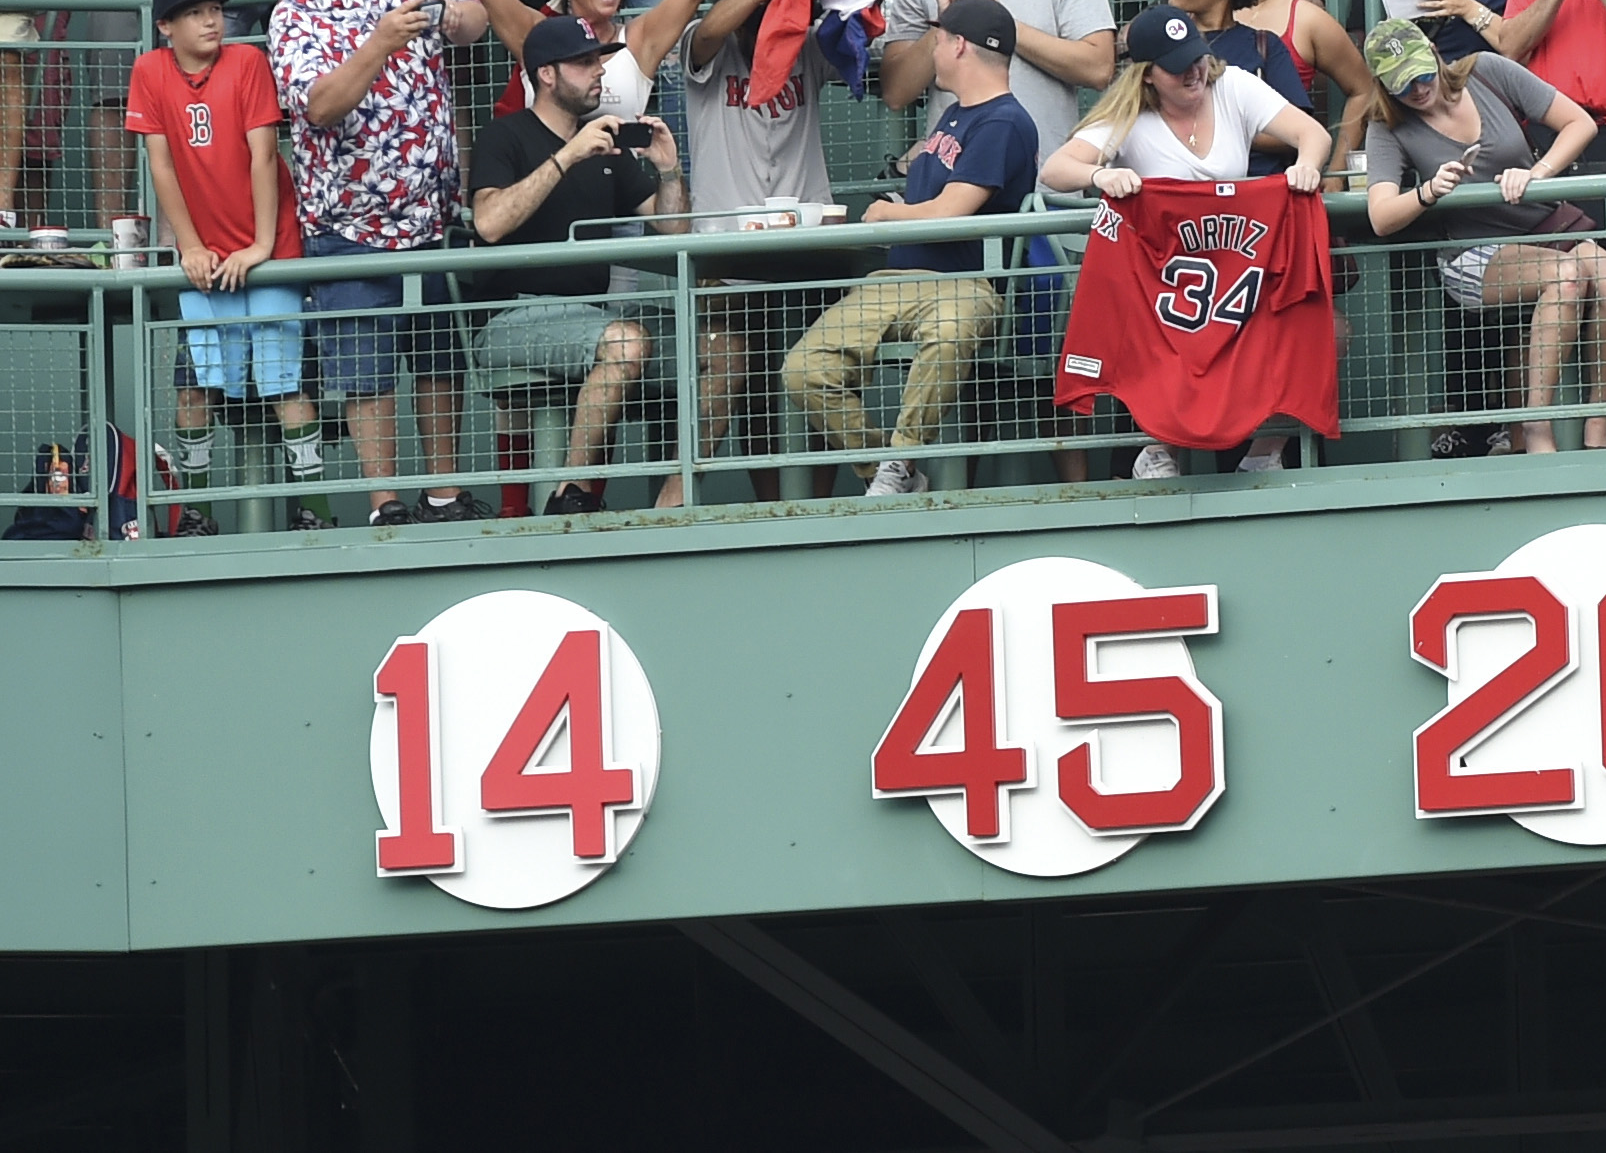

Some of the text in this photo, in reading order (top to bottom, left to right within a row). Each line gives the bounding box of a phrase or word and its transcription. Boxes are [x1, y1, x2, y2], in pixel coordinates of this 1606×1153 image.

[1167, 20, 1185, 37] 34
[725, 73, 804, 119] BOTON
[185, 102, 213, 147] B
[1178, 214, 1268, 259] ORTIZ
[1155, 255, 1264, 333] 34
[871, 586, 1222, 842] 45
[376, 628, 640, 874] 14
